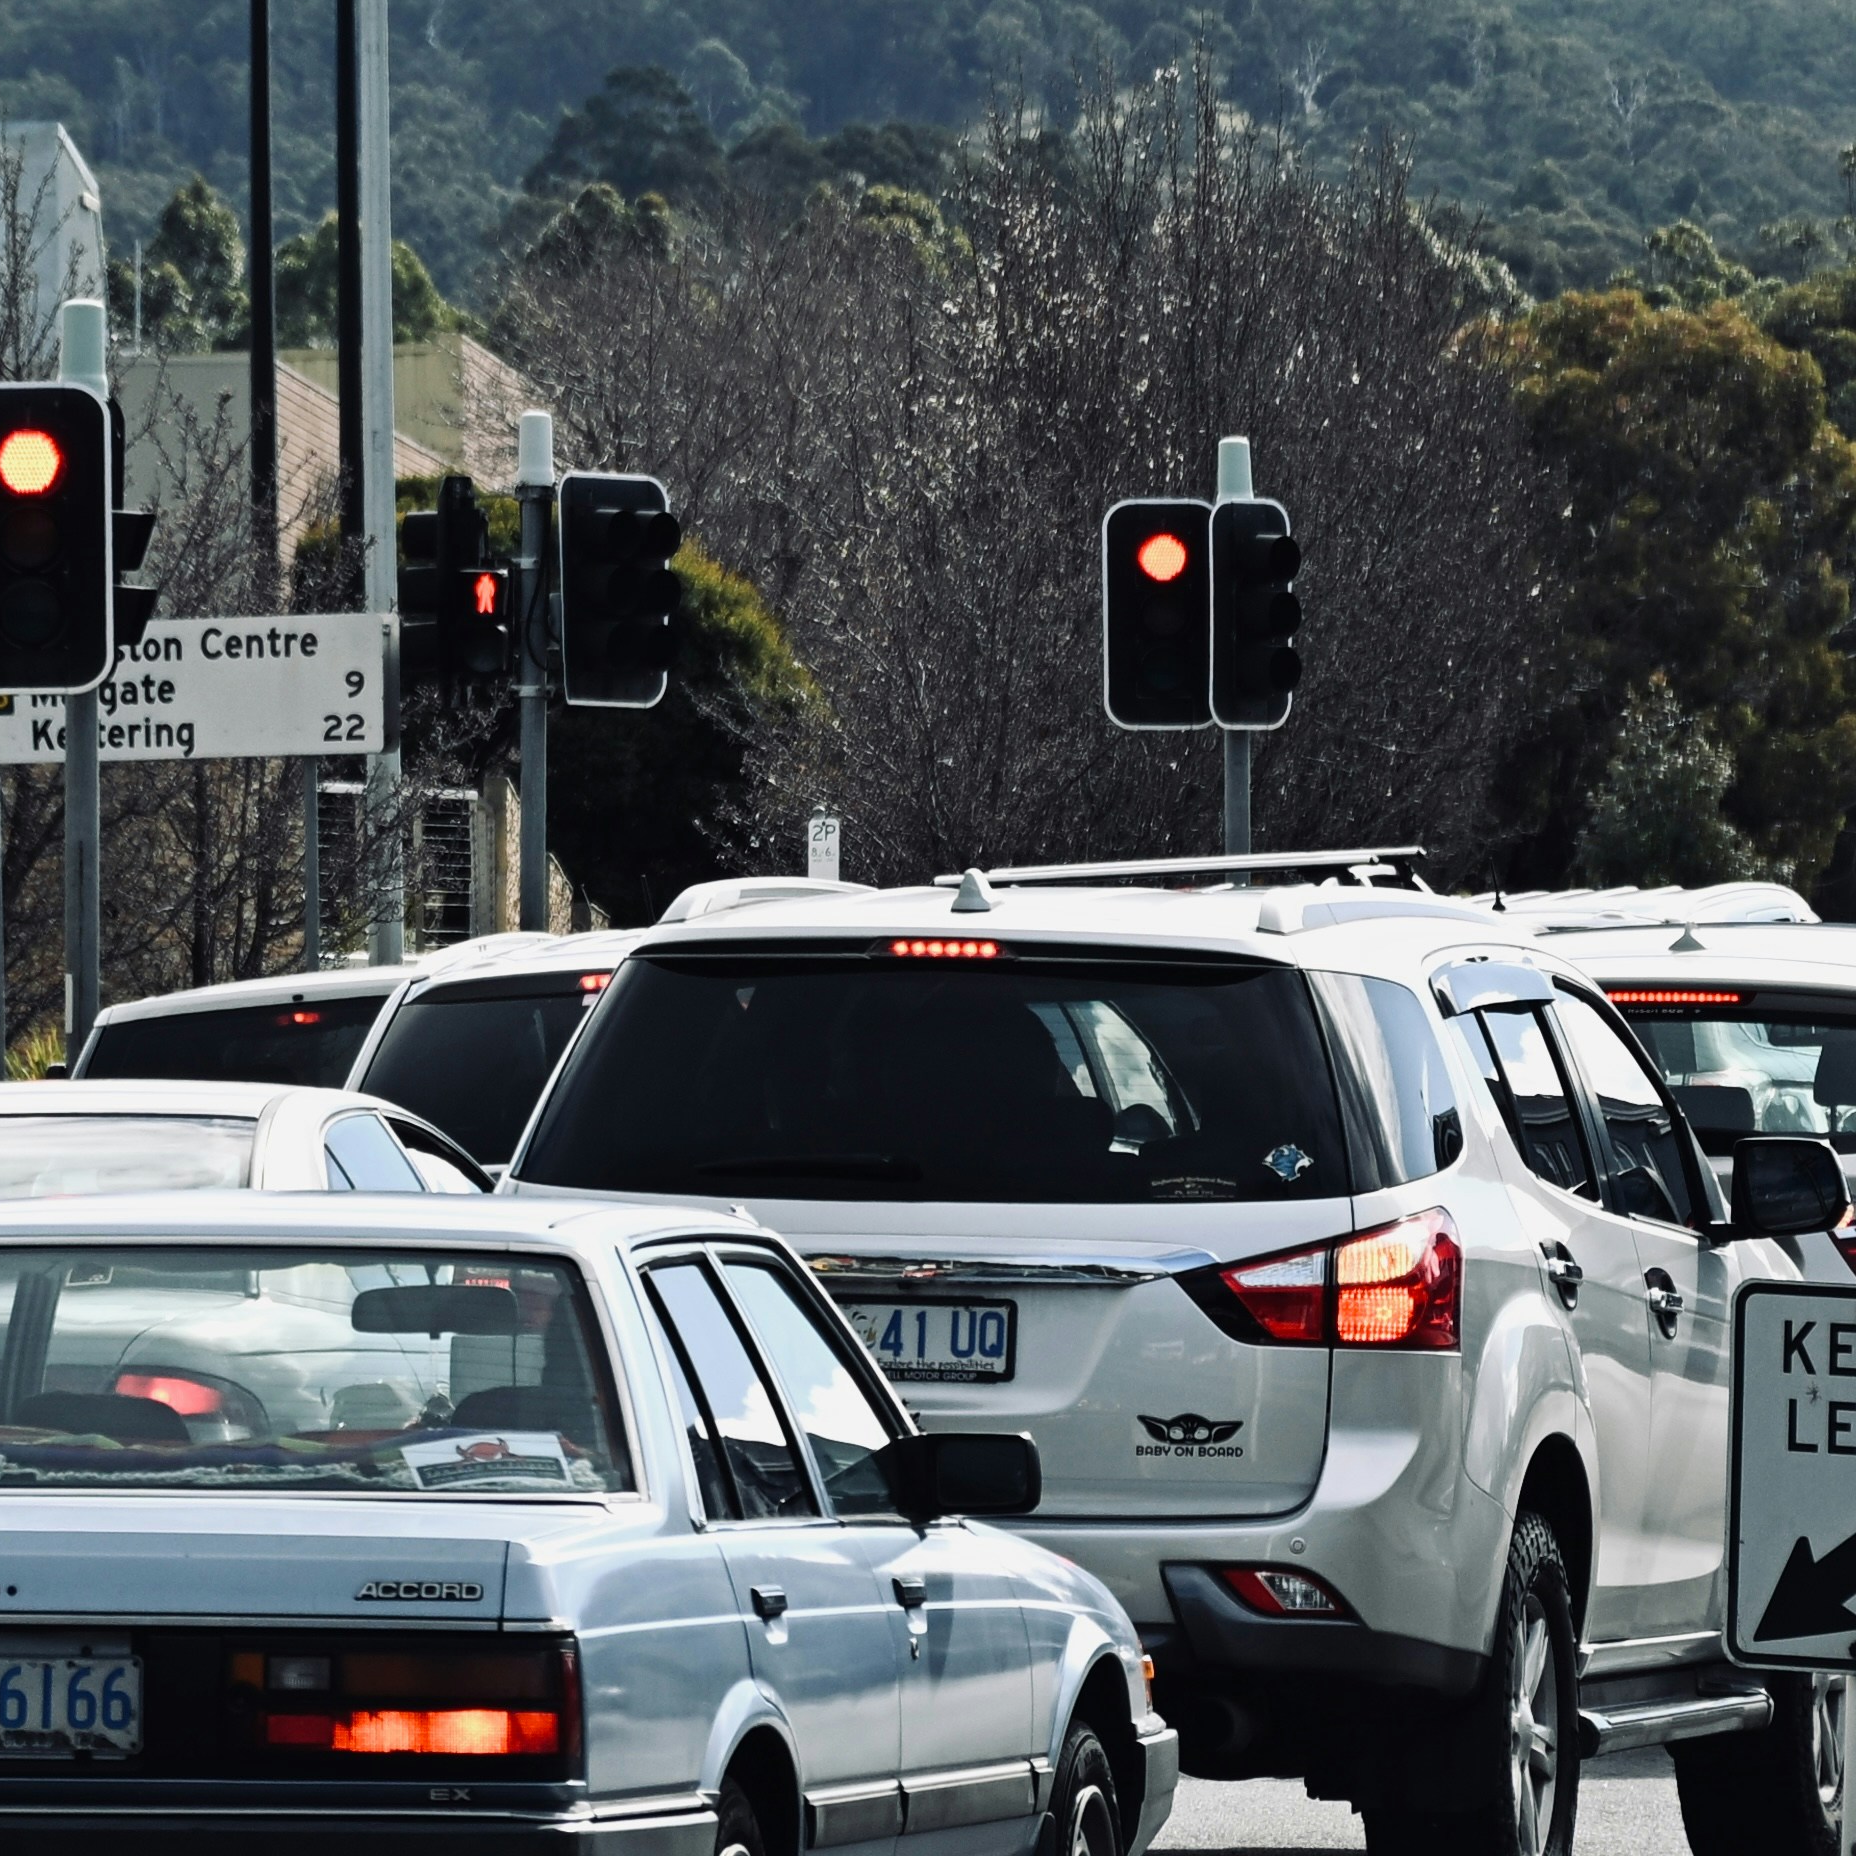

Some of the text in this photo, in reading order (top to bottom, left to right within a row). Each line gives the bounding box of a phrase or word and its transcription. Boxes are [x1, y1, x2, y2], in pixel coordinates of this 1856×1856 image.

[116, 627, 319, 662] ston Centre
[31, 671, 365, 716] gate 9
[32, 713, 365, 758] Ketering 22
[812, 824, 836, 841] 2P
[879, 1308, 1005, 1358] 41 UQ
[916, 1357, 936, 1369] the
[938, 1358, 995, 1371] possibilities
[904, 1370, 941, 1381] MOTOR
[943, 1371, 977, 1381] GROUP
[1136, 1445, 1244, 1458] BABY ON BOARD
[355, 1581, 484, 1600] ACCORD
[430, 1788, 472, 1801] EX
